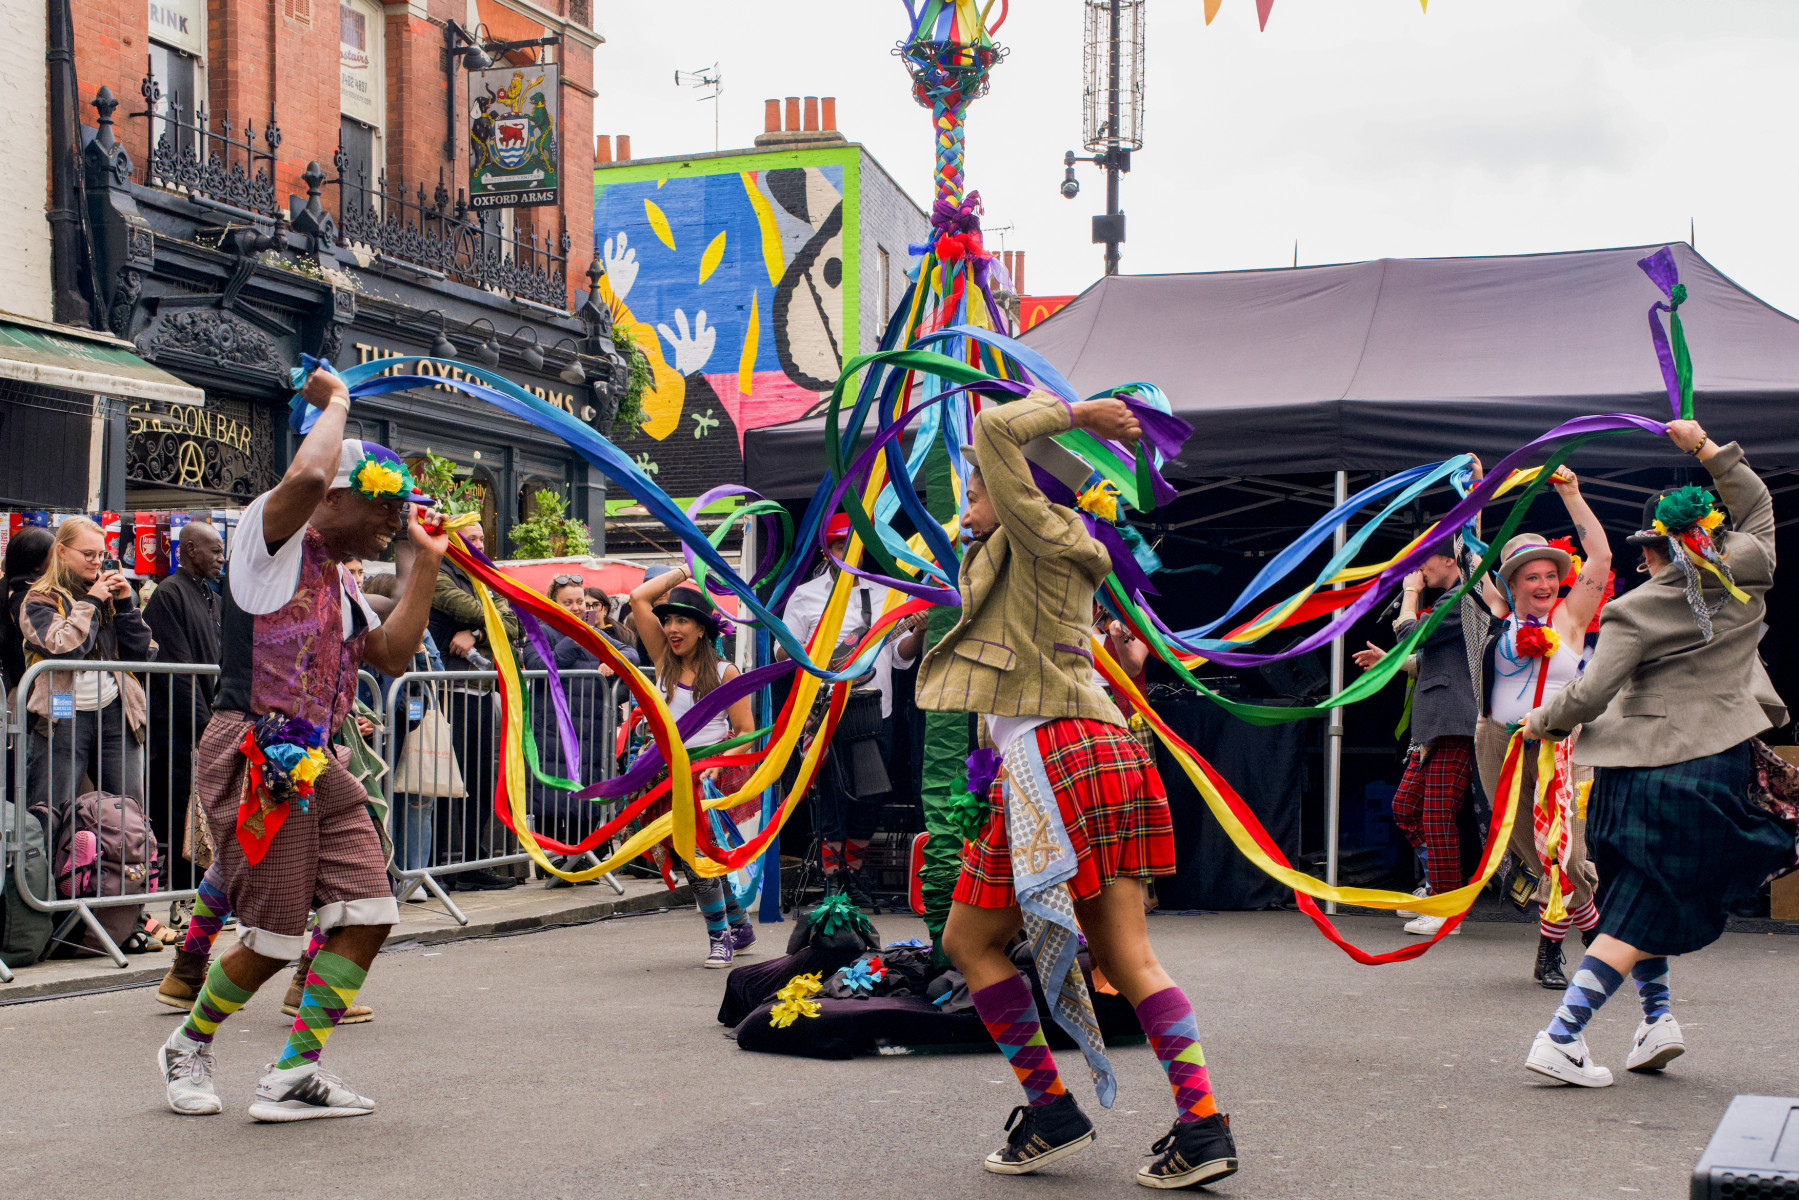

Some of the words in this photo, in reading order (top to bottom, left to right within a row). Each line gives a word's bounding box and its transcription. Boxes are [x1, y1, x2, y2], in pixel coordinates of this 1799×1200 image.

[473, 194, 518, 207] OXFORD
[520, 191, 554, 203] ARMS
[416, 359, 497, 399] OXFO
[129, 402, 211, 438] SALOON
[217, 414, 252, 456] BAR
